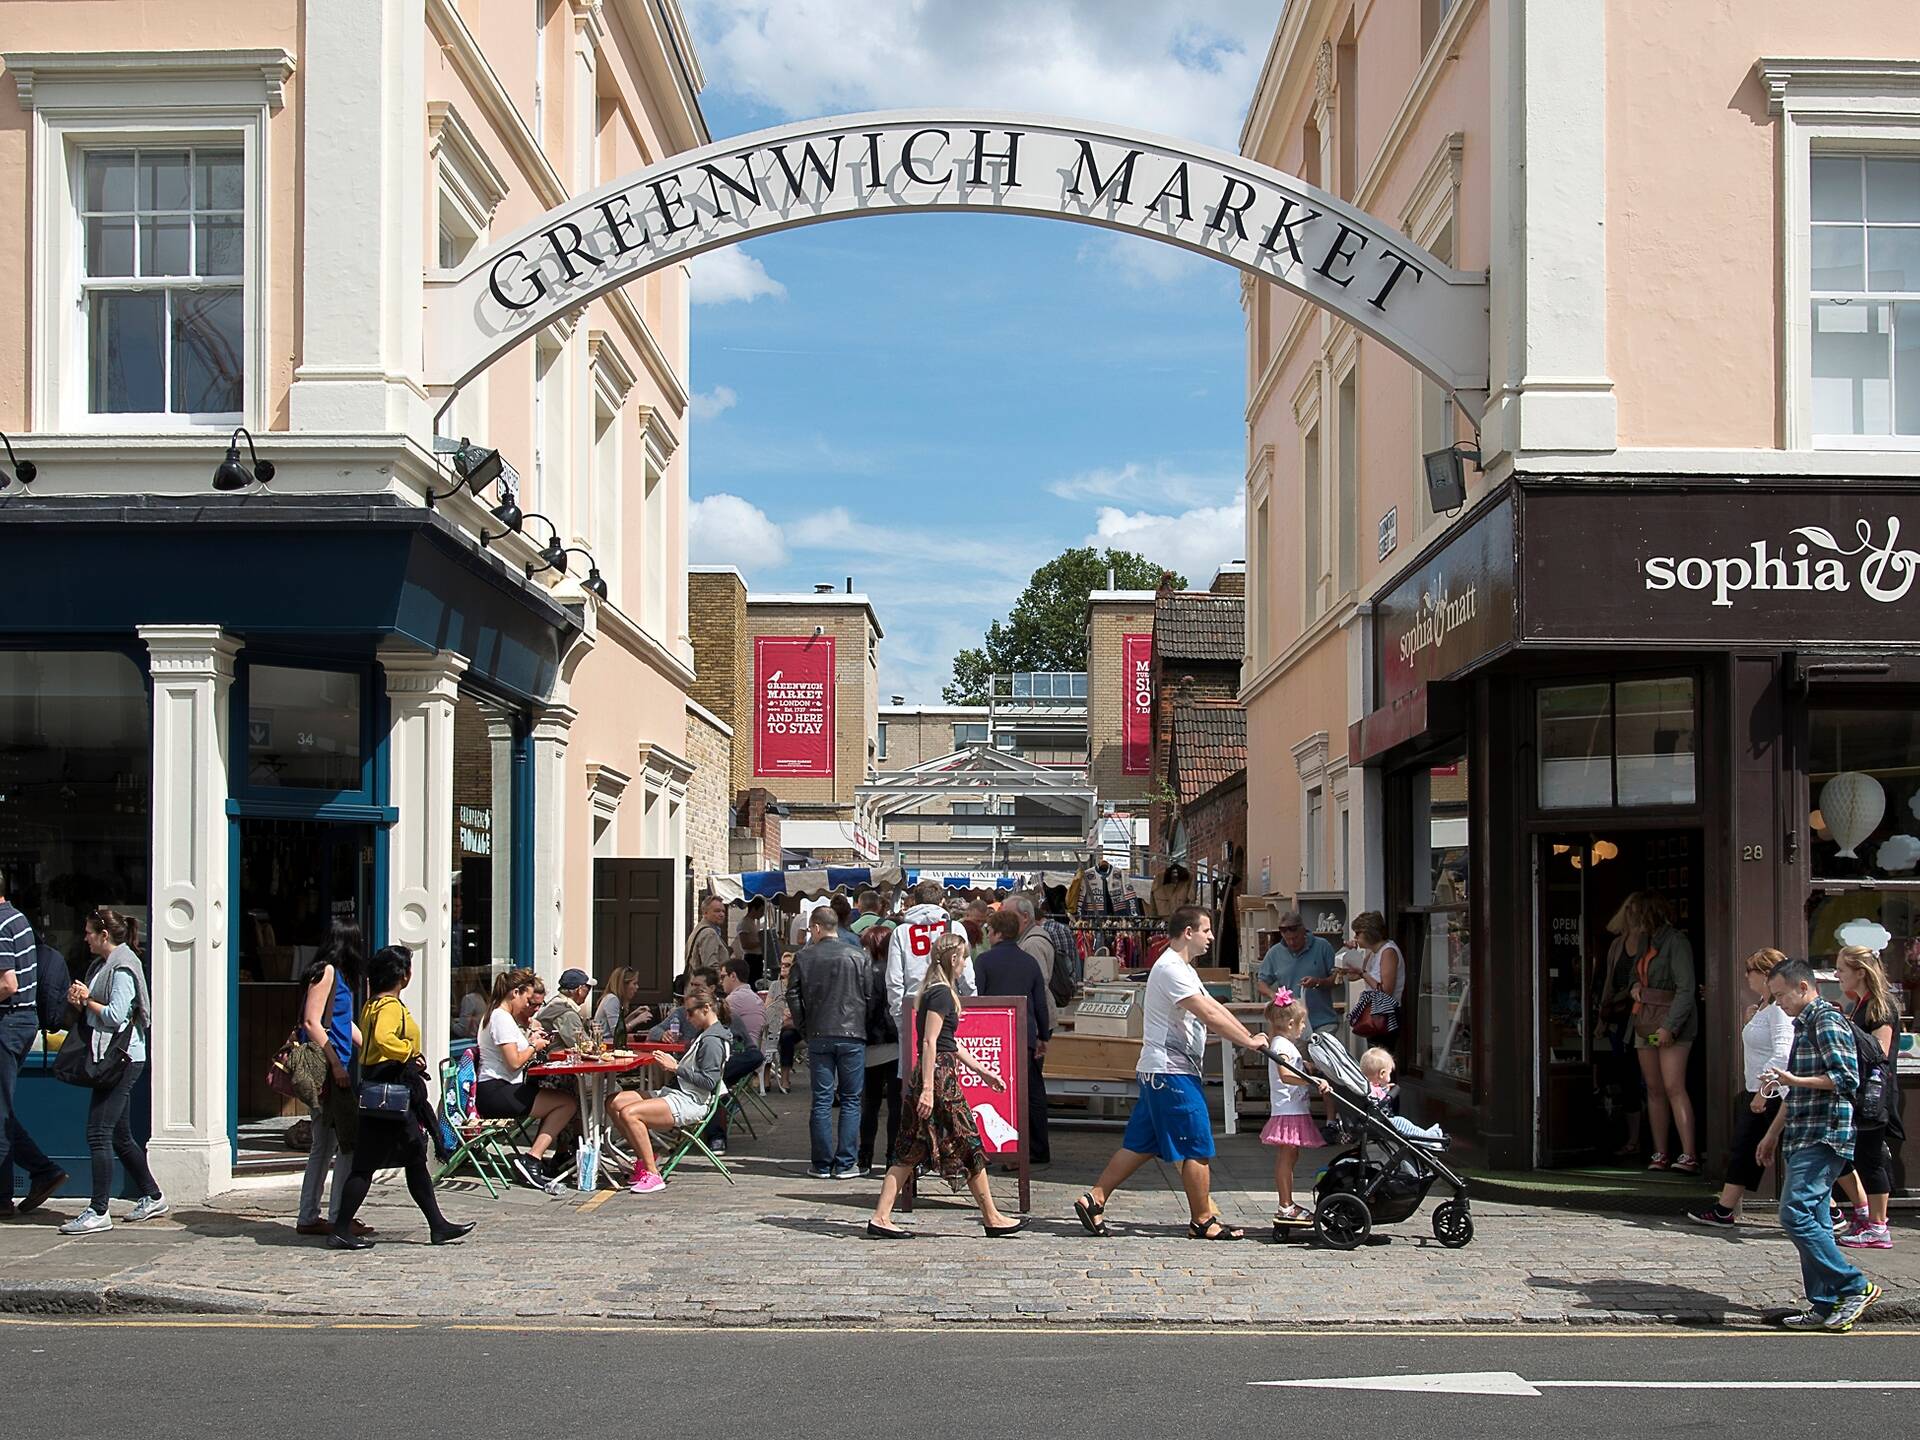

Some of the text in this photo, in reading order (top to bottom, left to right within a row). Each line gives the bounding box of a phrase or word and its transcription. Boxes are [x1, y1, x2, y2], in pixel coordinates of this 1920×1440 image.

[488, 128, 1424, 312] GREENWICH MARKET
[1645, 540, 1851, 606] sophia
[1400, 608, 1433, 668] sophia
[1446, 579, 1476, 632] matt
[767, 690, 823, 699] MARKET
[767, 713, 823, 722] AND HERE
[767, 723, 822, 733] TO STAY
[297, 732, 314, 746] 34
[1743, 845, 1763, 860] 28
[1552, 917, 1577, 930] OPEN
[1081, 1002, 1127, 1013] POTATOES
[953, 1036, 1001, 1047] NWICH
[968, 1047, 1002, 1060] KET
